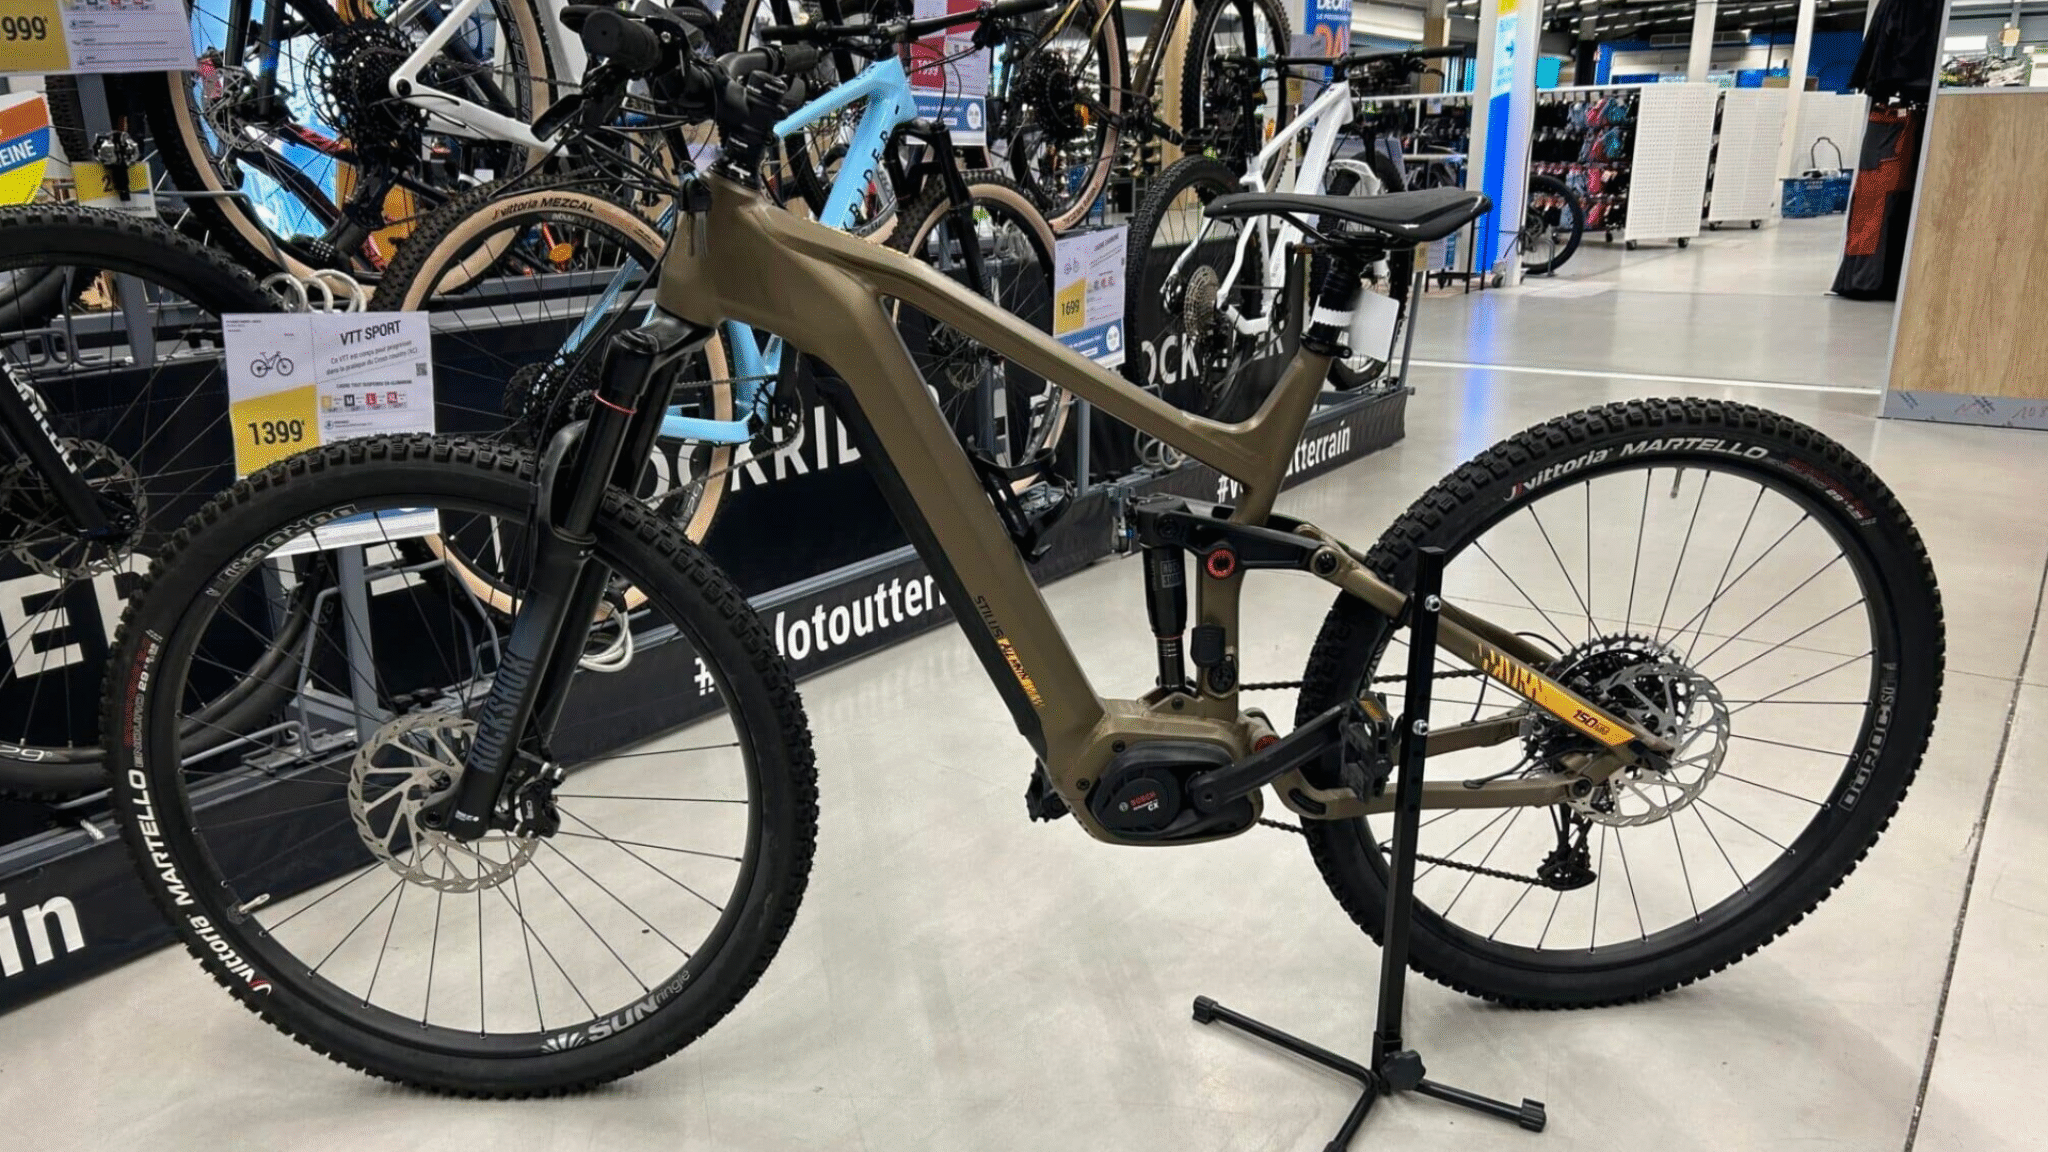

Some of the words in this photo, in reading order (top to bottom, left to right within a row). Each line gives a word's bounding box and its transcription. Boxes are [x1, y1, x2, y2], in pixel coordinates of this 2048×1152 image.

[1, 16, 48, 41] 999
[0, 139, 37, 168] EINE
[501, 200, 538, 217] vittoria
[540, 198, 594, 213] MEZCAL
[340, 329, 363, 346] VTT
[364, 320, 402, 341] SPORT
[248, 419, 305, 446] 1399
[1523, 447, 1609, 490] vittoria
[1619, 437, 1769, 460] MARTELLO
[974, 594, 1005, 639] STILUS
[467, 651, 534, 774] ROCKSHOX
[1837, 705, 1892, 812] DUROC
[1148, 800, 1159, 812] CX
[127, 769, 195, 906] MARTELLO
[189, 916, 254, 982] vittoria
